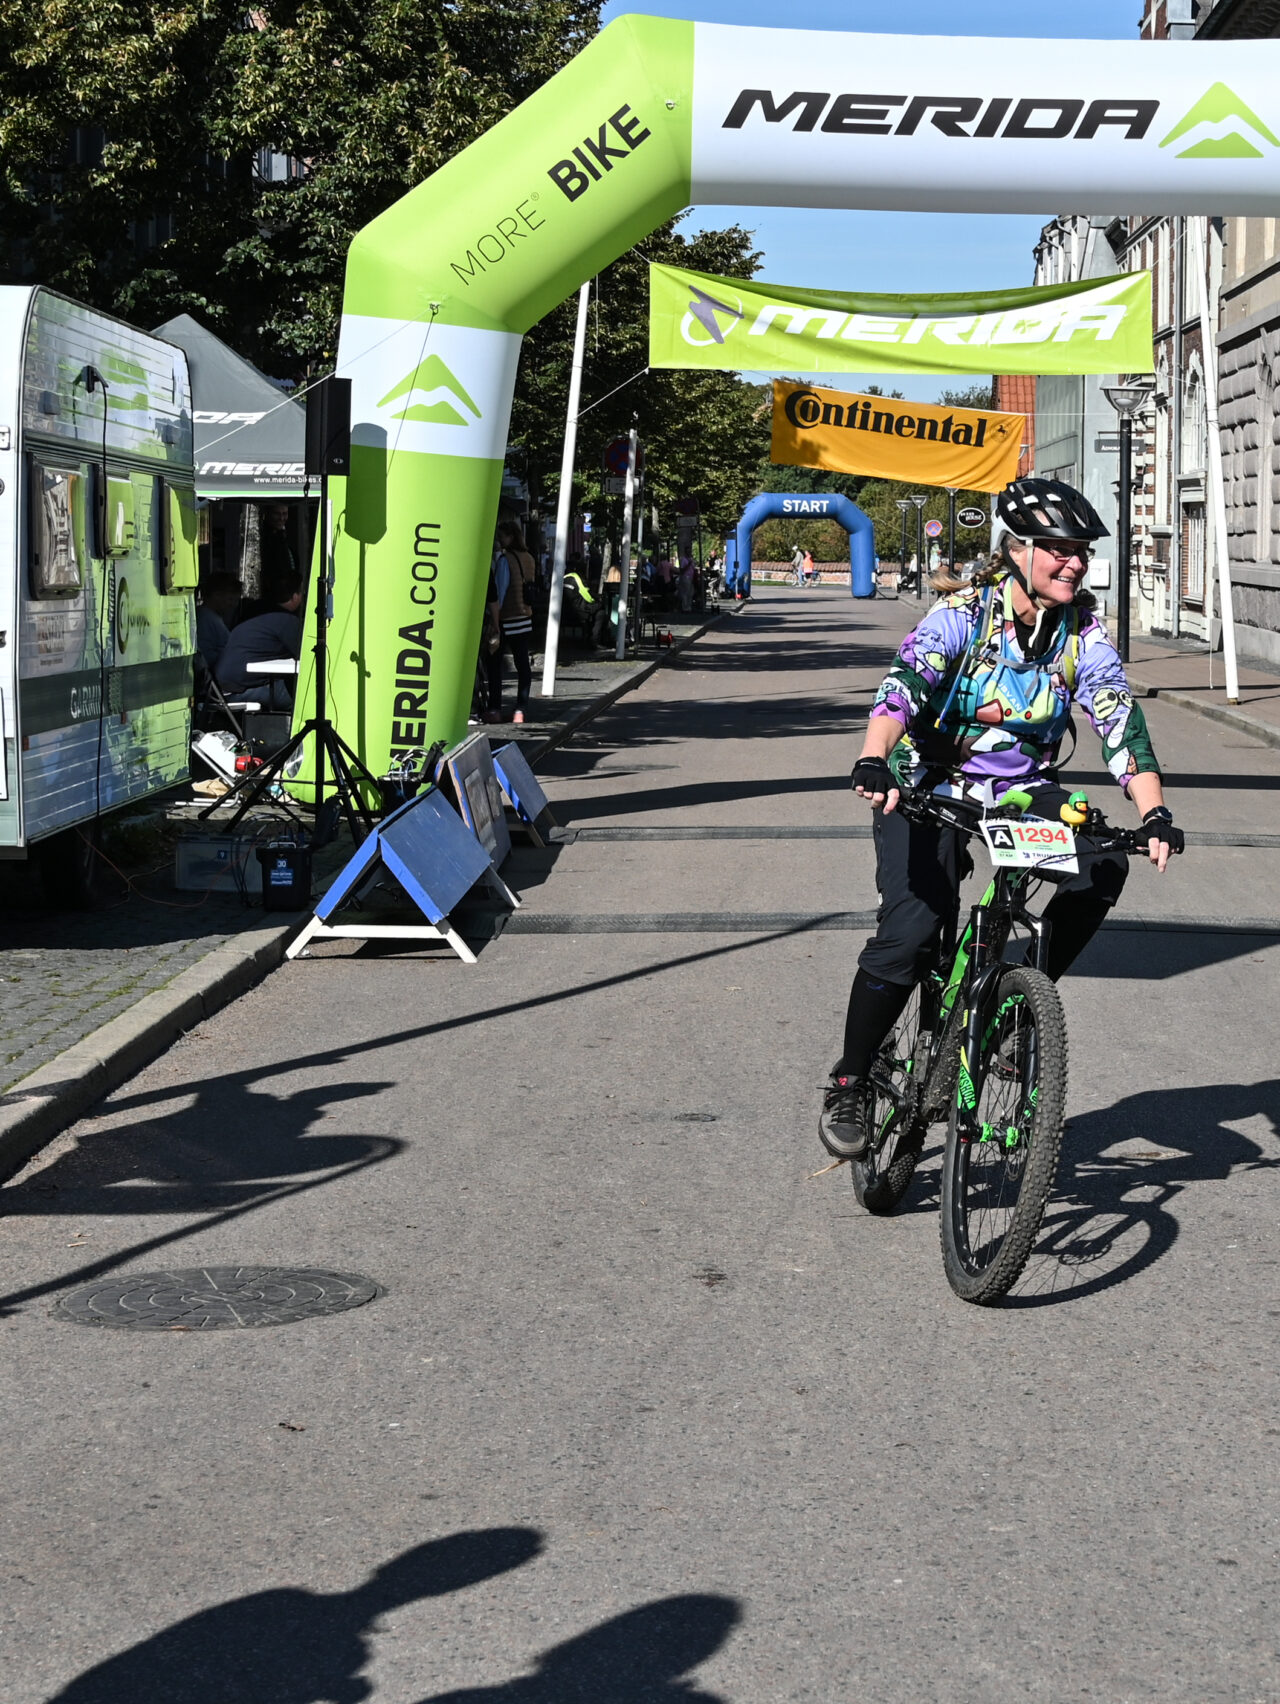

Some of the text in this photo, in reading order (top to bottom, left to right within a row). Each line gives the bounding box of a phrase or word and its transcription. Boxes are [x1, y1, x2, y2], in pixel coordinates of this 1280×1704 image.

[722, 89, 1160, 139] MERIDA
[547, 103, 651, 202] BIKE
[748, 304, 1127, 345] MERIDA
[784, 390, 987, 447] Continental
[199, 461, 306, 476] MERID
[782, 499, 829, 513] START
[994, 827, 1069, 846] A 1294
